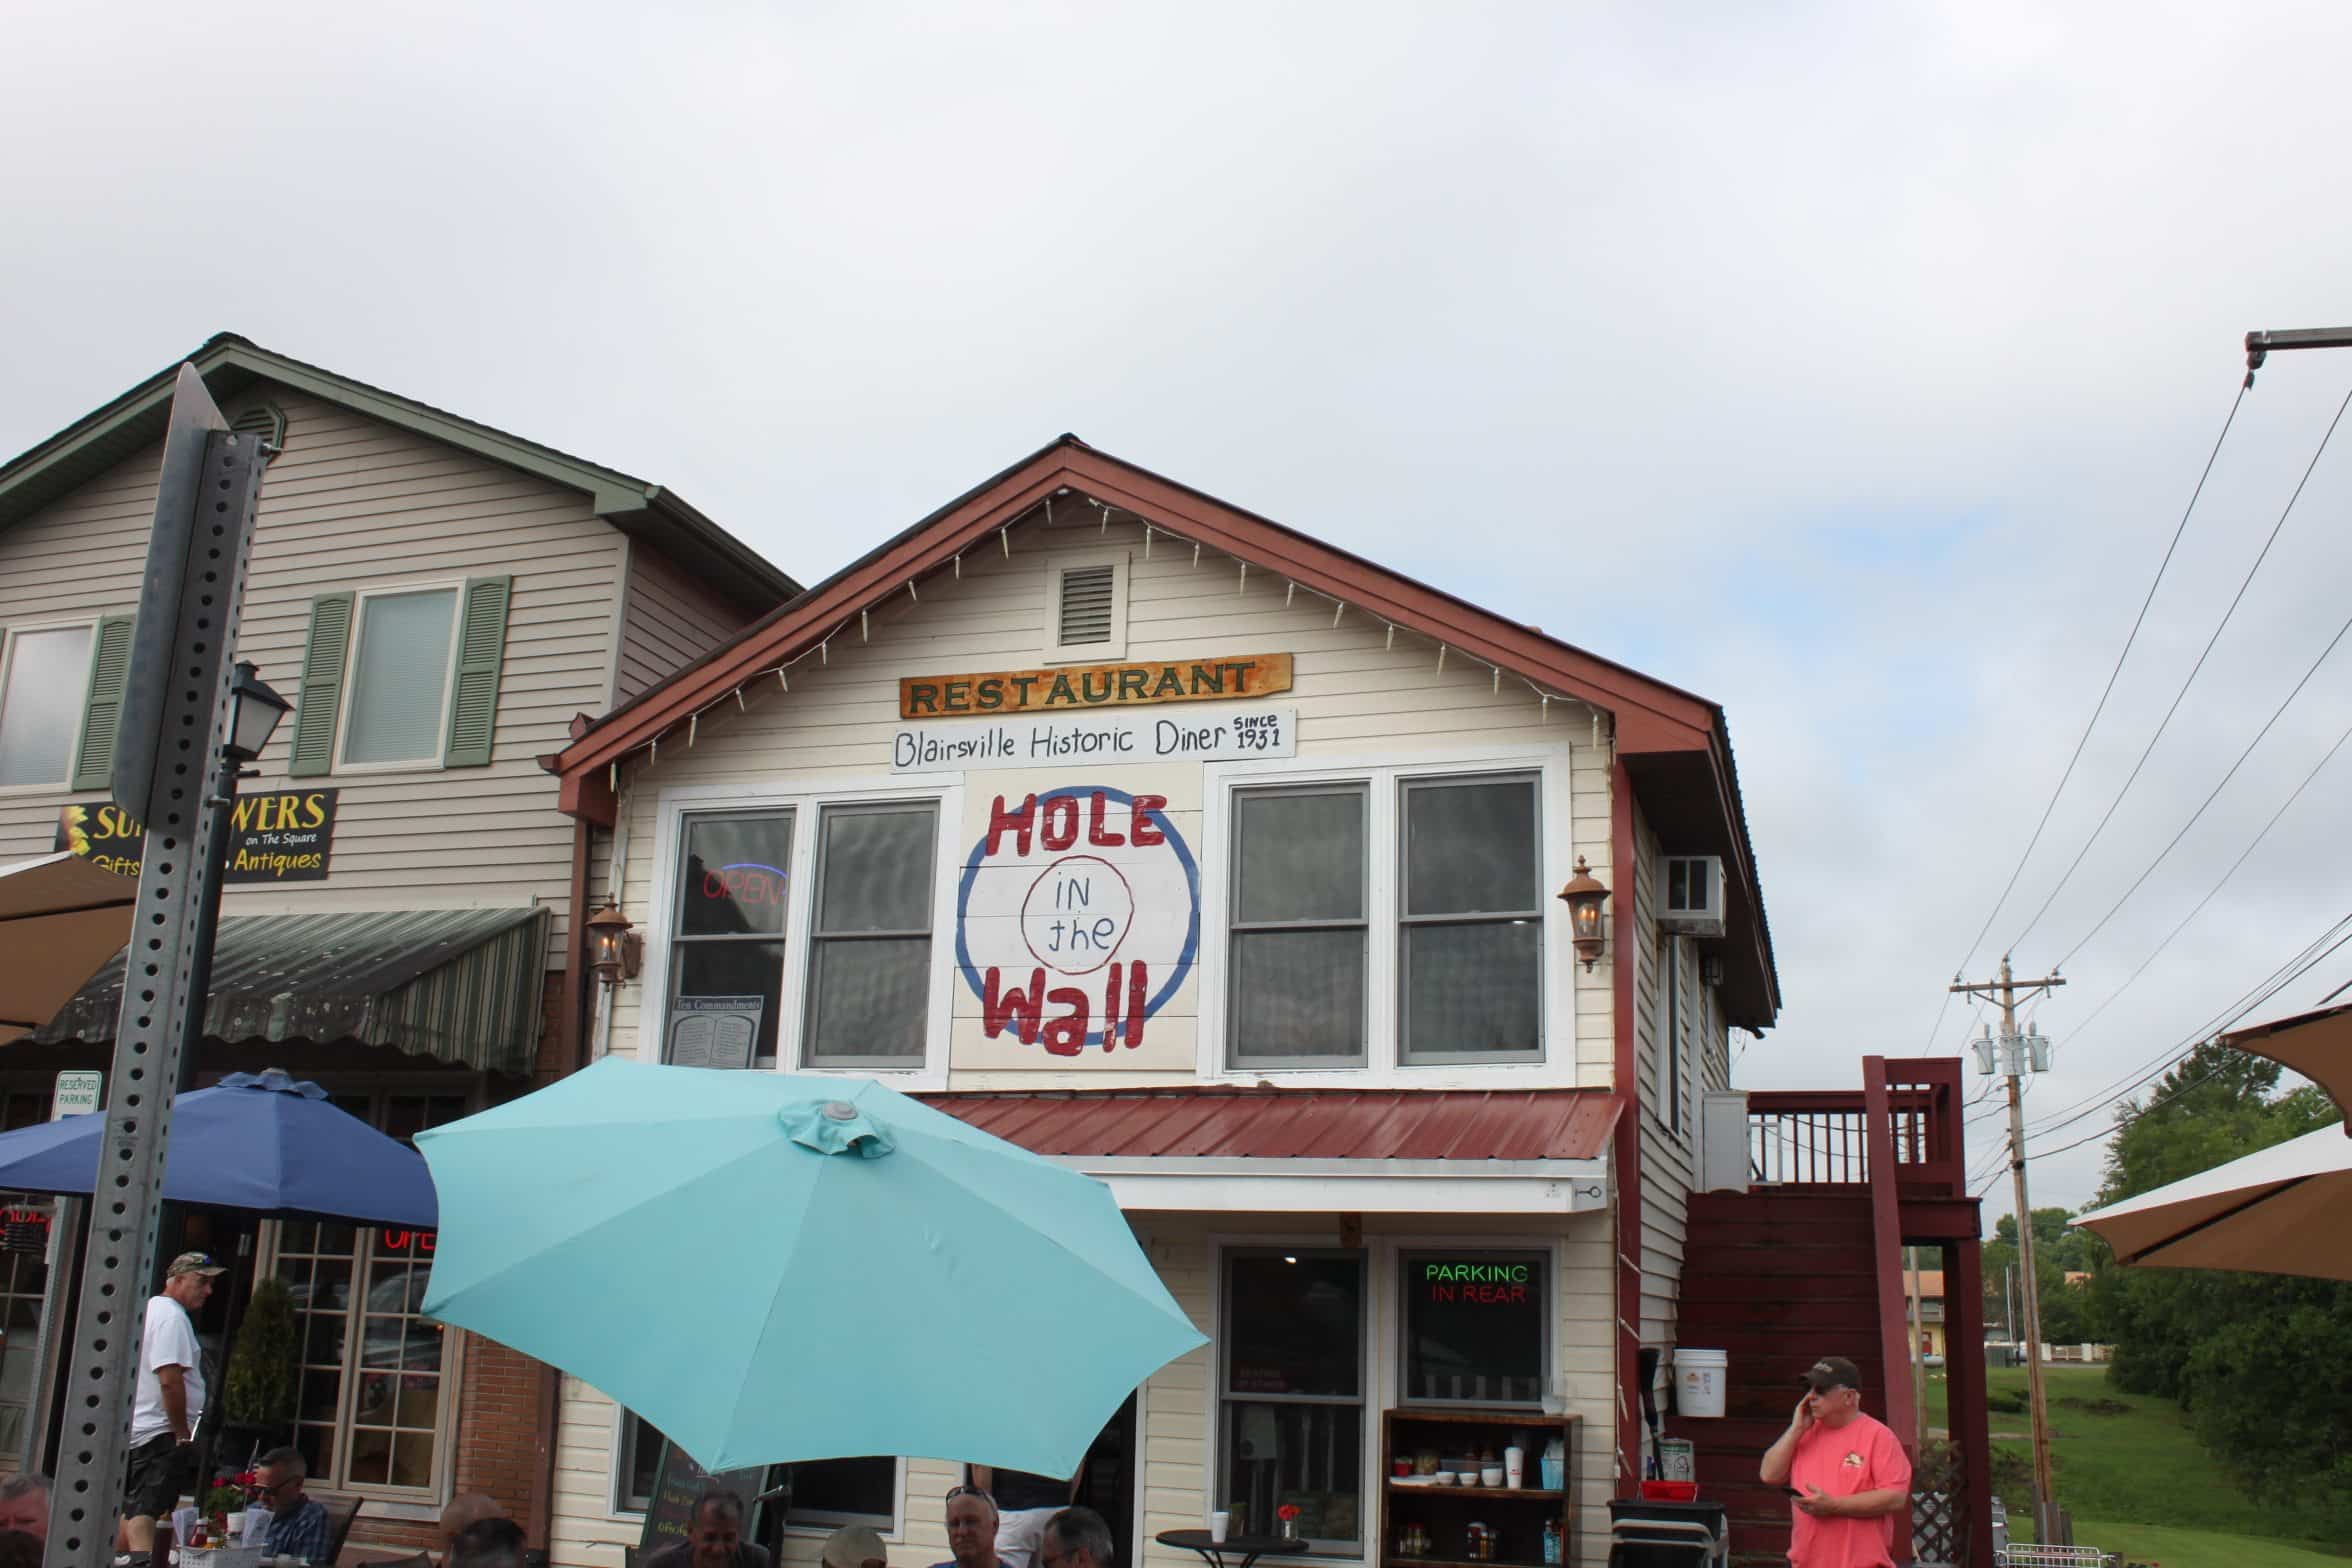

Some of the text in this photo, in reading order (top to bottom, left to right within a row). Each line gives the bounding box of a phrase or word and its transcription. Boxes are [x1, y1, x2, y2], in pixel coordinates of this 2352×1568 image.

[909, 661, 1257, 714] RESTAURANT
[895, 719, 1227, 767] Blairsville Historic Diner
[1237, 727, 1281, 751] 1931
[262, 832, 280, 845] The
[282, 831, 319, 846] Square
[984, 791, 1168, 857] HOLE
[233, 848, 322, 878] Antiques
[703, 867, 784, 906] OPEN
[1048, 917, 1115, 952] the
[982, 959, 1148, 1057] Wall
[59, 1079, 97, 1090] RESERVED
[59, 1094, 93, 1105] PARKING
[1426, 1264, 1529, 1283] PARKING
[1432, 1284, 1527, 1303] IN REAR
